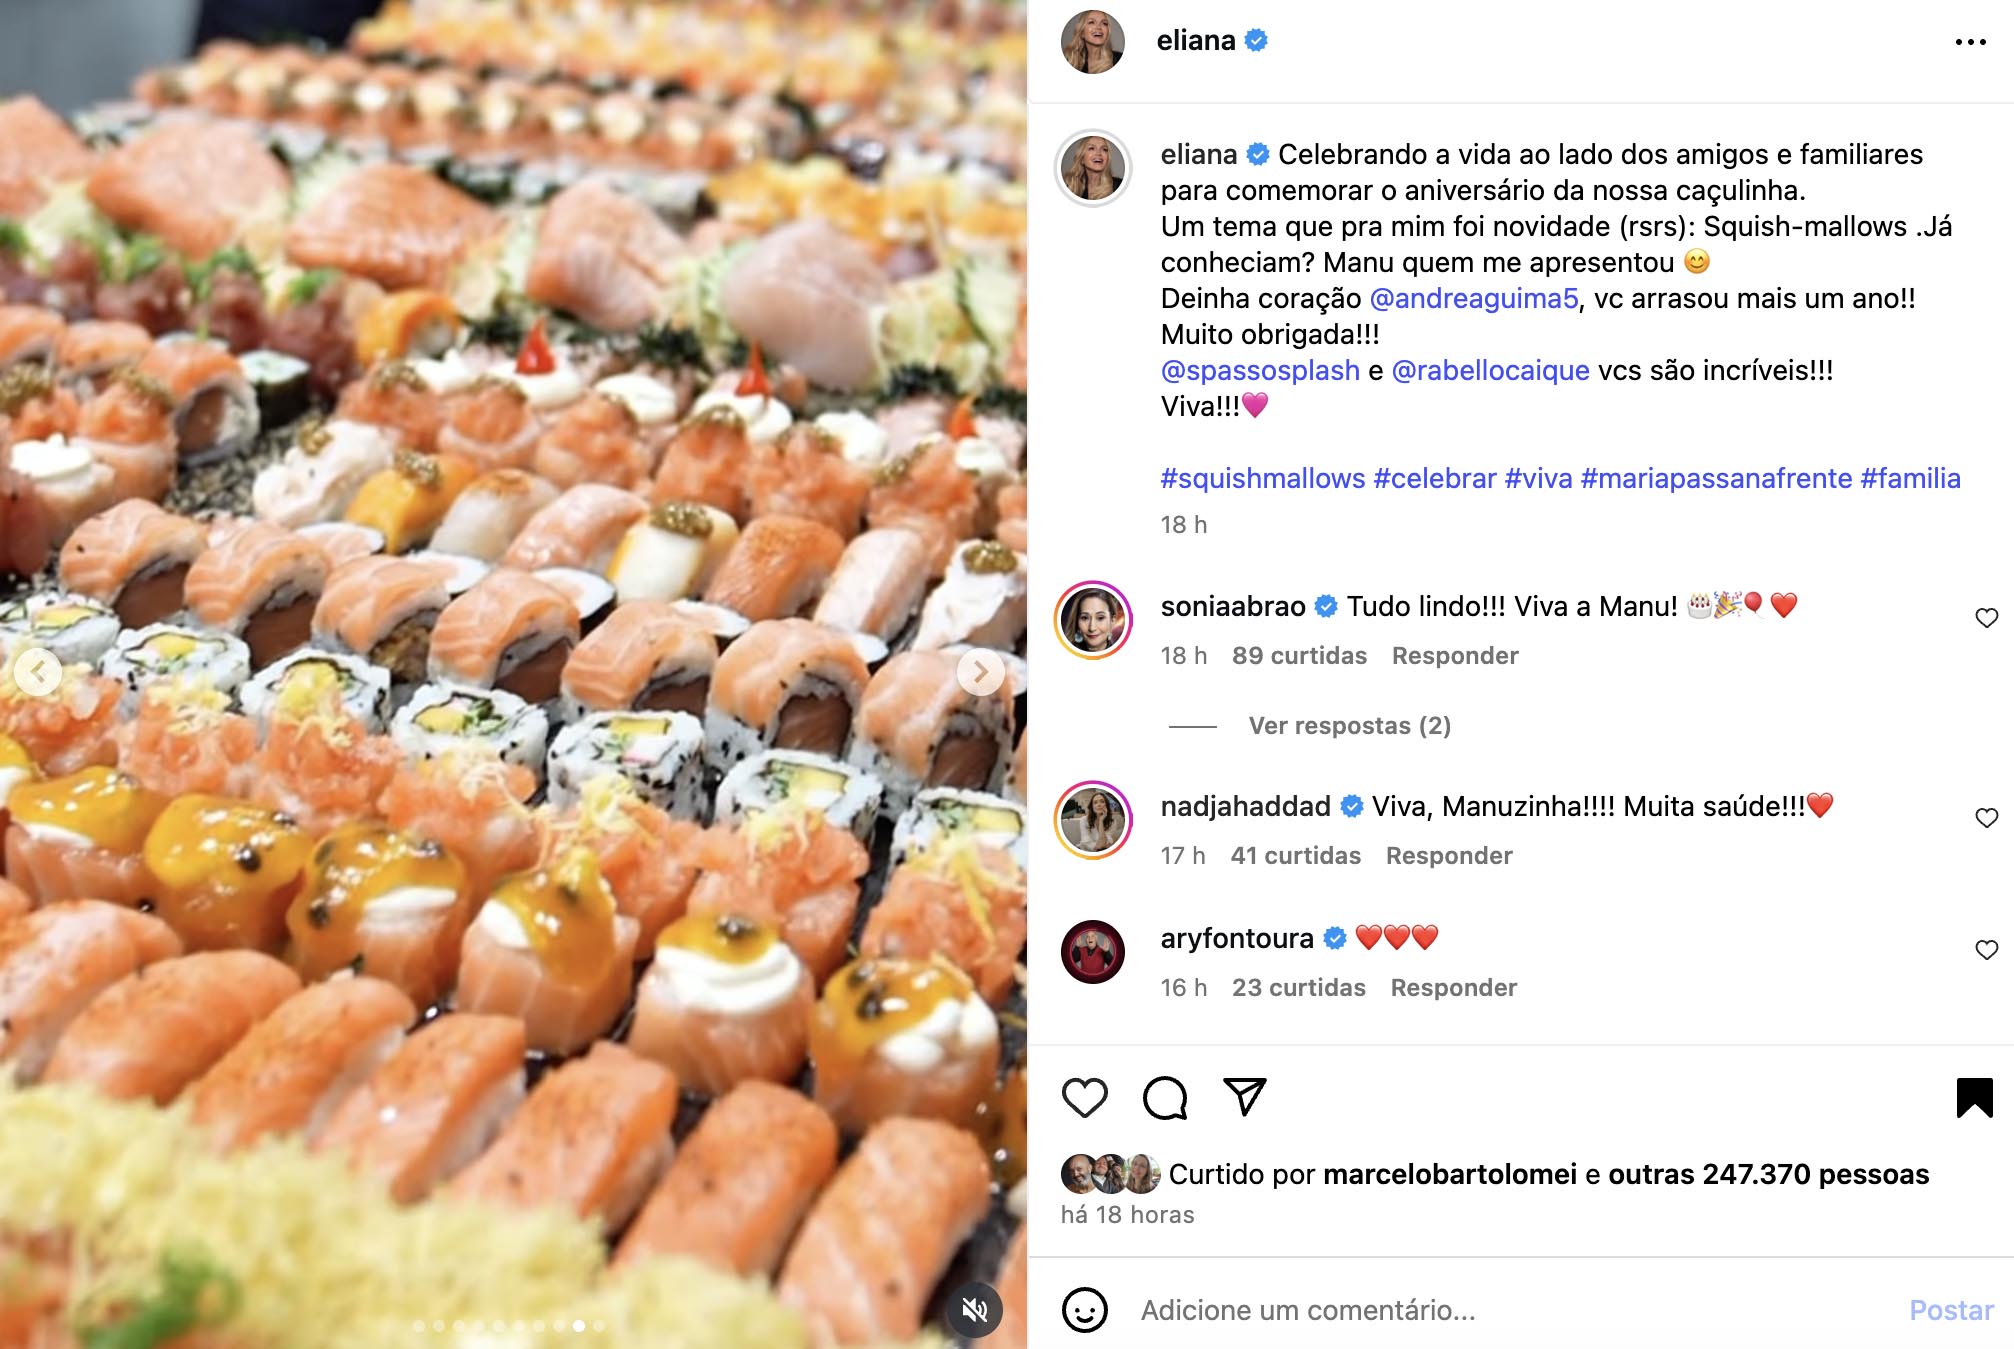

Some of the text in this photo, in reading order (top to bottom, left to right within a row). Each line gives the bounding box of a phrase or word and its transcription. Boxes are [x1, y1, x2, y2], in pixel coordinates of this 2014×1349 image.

[1157, 28, 1235, 51] eliana
[1161, 142, 1923, 169] eliana Celebrando a vida ao lado dos amigos e familiares
[1162, 178, 1805, 207] para comemorar o aniversário da nossa caçulinha.
[1163, 214, 1952, 241] Um tema que pra mim foi novidade (rsrs): Squish-mallows .Já
[1162, 251, 1673, 277] conheciam? Manu quem me apresentou
[1162, 287, 1914, 315] Deinha coração @andreaguima5, vc arrasou mais um ano!!
[1163, 323, 1378, 349] Muito obrigada!!!
[1162, 358, 1832, 385] @spassosplash e @rabellocaique vcs são incríveis!!!
[1161, 394, 1239, 416] Viva!!!
[1161, 467, 1960, 493] #squishmallows #celebrar #viva #mariapassanafrente #familia
[1162, 515, 1206, 533] 18 h
[1162, 594, 1677, 617] soniaabrao Tudo lindo!!! Viva a Manu!
[1162, 646, 1206, 664] 18 h
[1233, 645, 1367, 664] 89 curtidas
[1393, 646, 1519, 668] Responder
[1249, 716, 1450, 739] Ver respostas (2)
[1162, 794, 1804, 821] nadjahaddad Viva, Manuzinha!!!! Muita saúde!!!
[1162, 846, 1205, 864] 17 h
[1231, 845, 1361, 864] 41 curtidas
[1387, 846, 1513, 868] Responder
[1161, 927, 1313, 953] aryfontoura
[1162, 978, 1206, 996] 16 h
[1233, 977, 1365, 996] 23 curtidas
[1392, 978, 1518, 1000] Responder
[1170, 1162, 1929, 1189] Curtido por marcelobartolomei e outras 247.370 pessoas
[1062, 1204, 1194, 1223] há 18 horas
[1141, 1298, 1474, 1320] Adicione um comentário...
[1912, 1300, 1994, 1320] Postar
